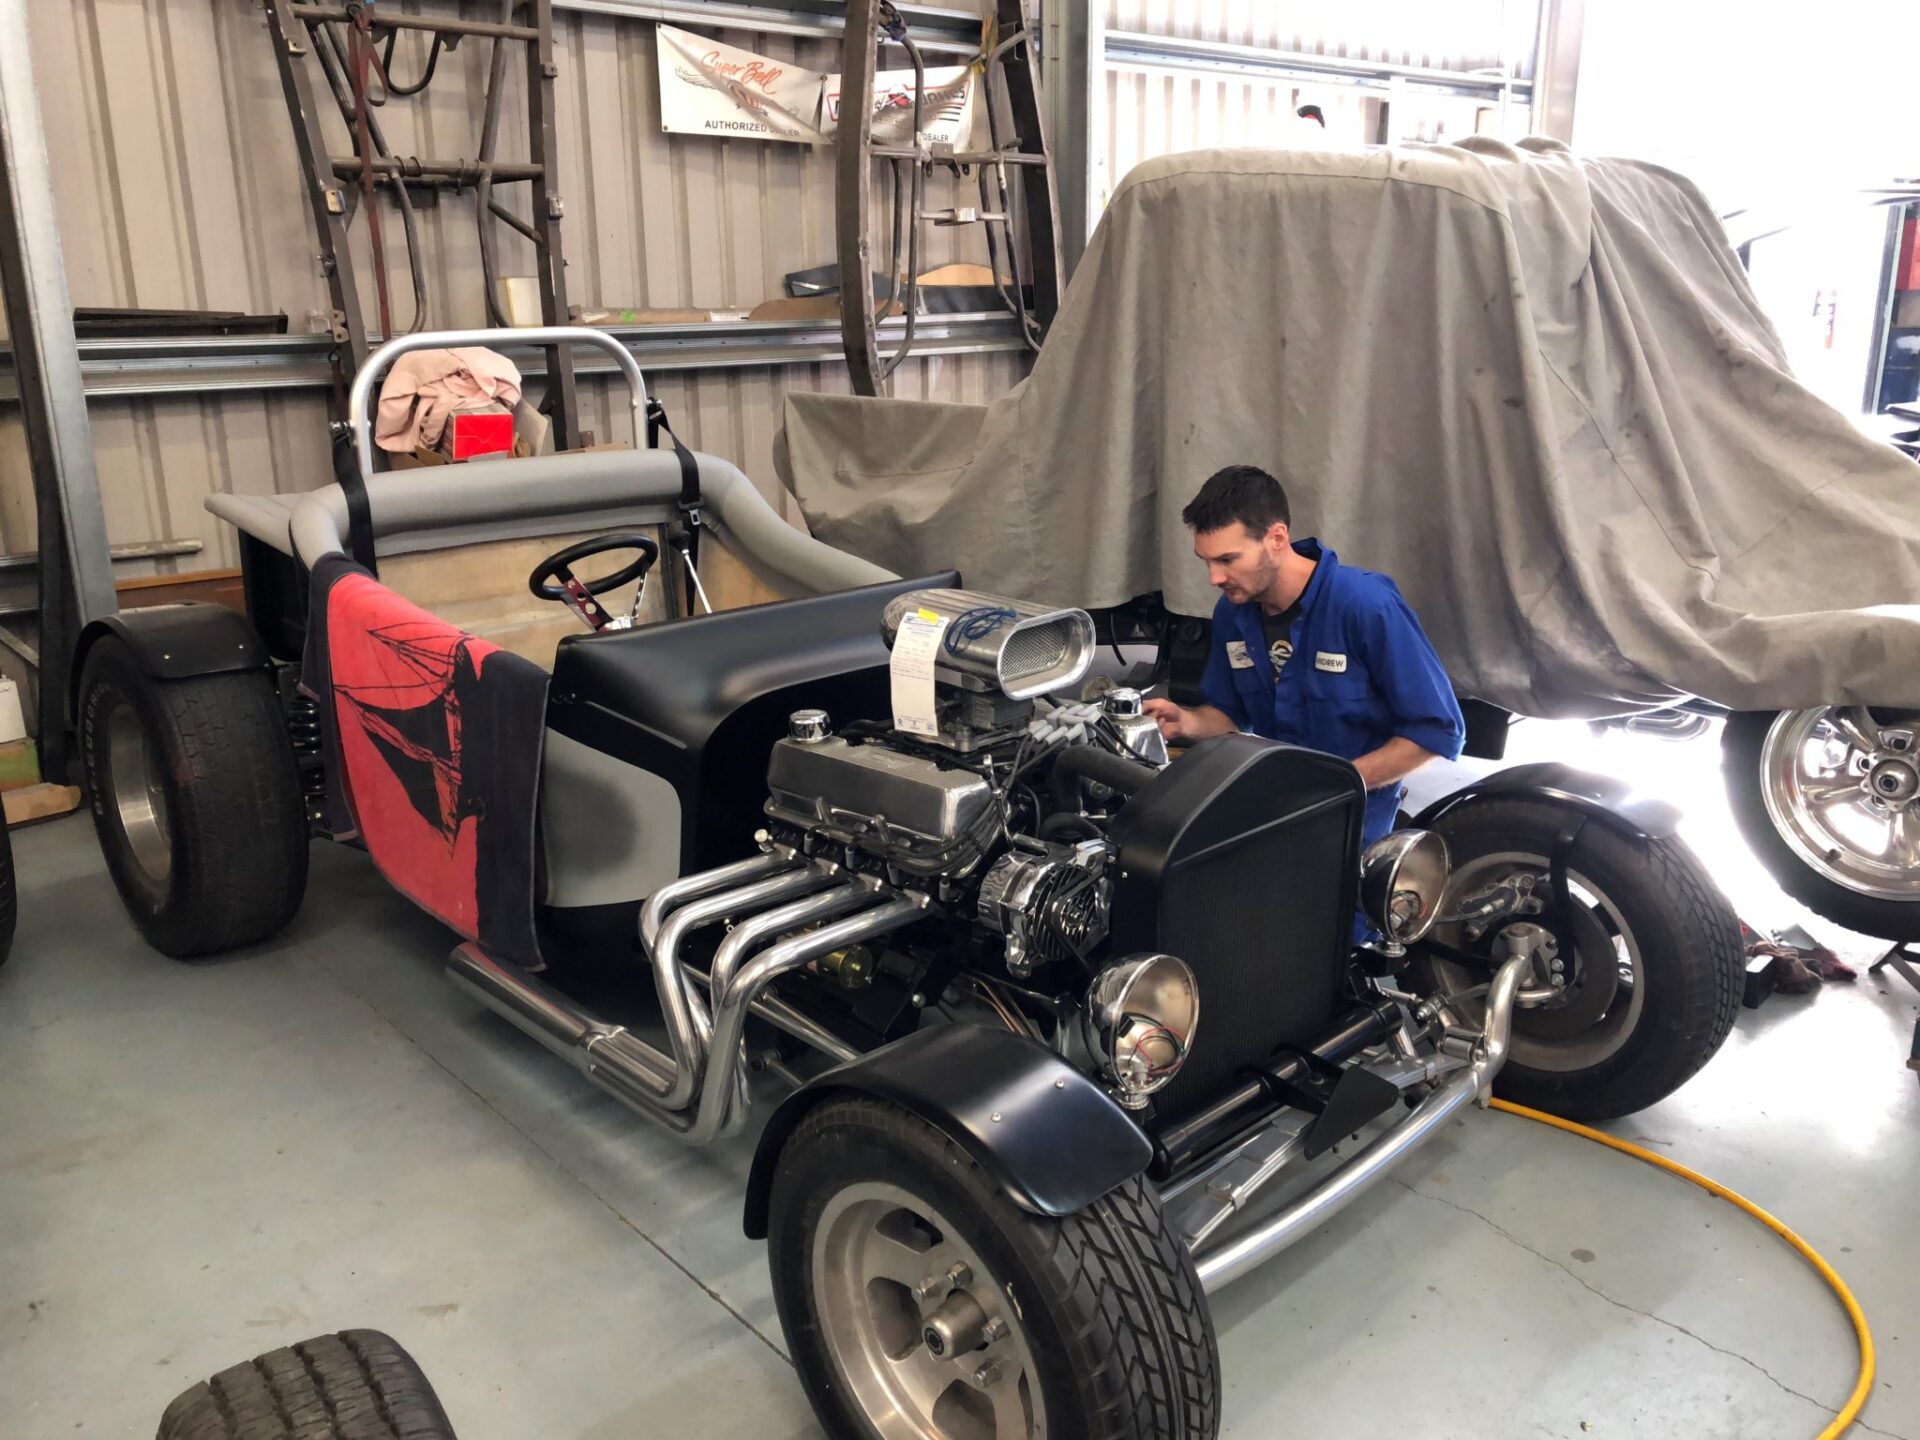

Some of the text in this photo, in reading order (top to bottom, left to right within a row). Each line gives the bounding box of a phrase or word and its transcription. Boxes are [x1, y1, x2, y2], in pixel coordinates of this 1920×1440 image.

[741, 61, 782, 94] Bell
[705, 120, 767, 132] AUTHORIZED
[922, 132, 949, 142] DEALER
